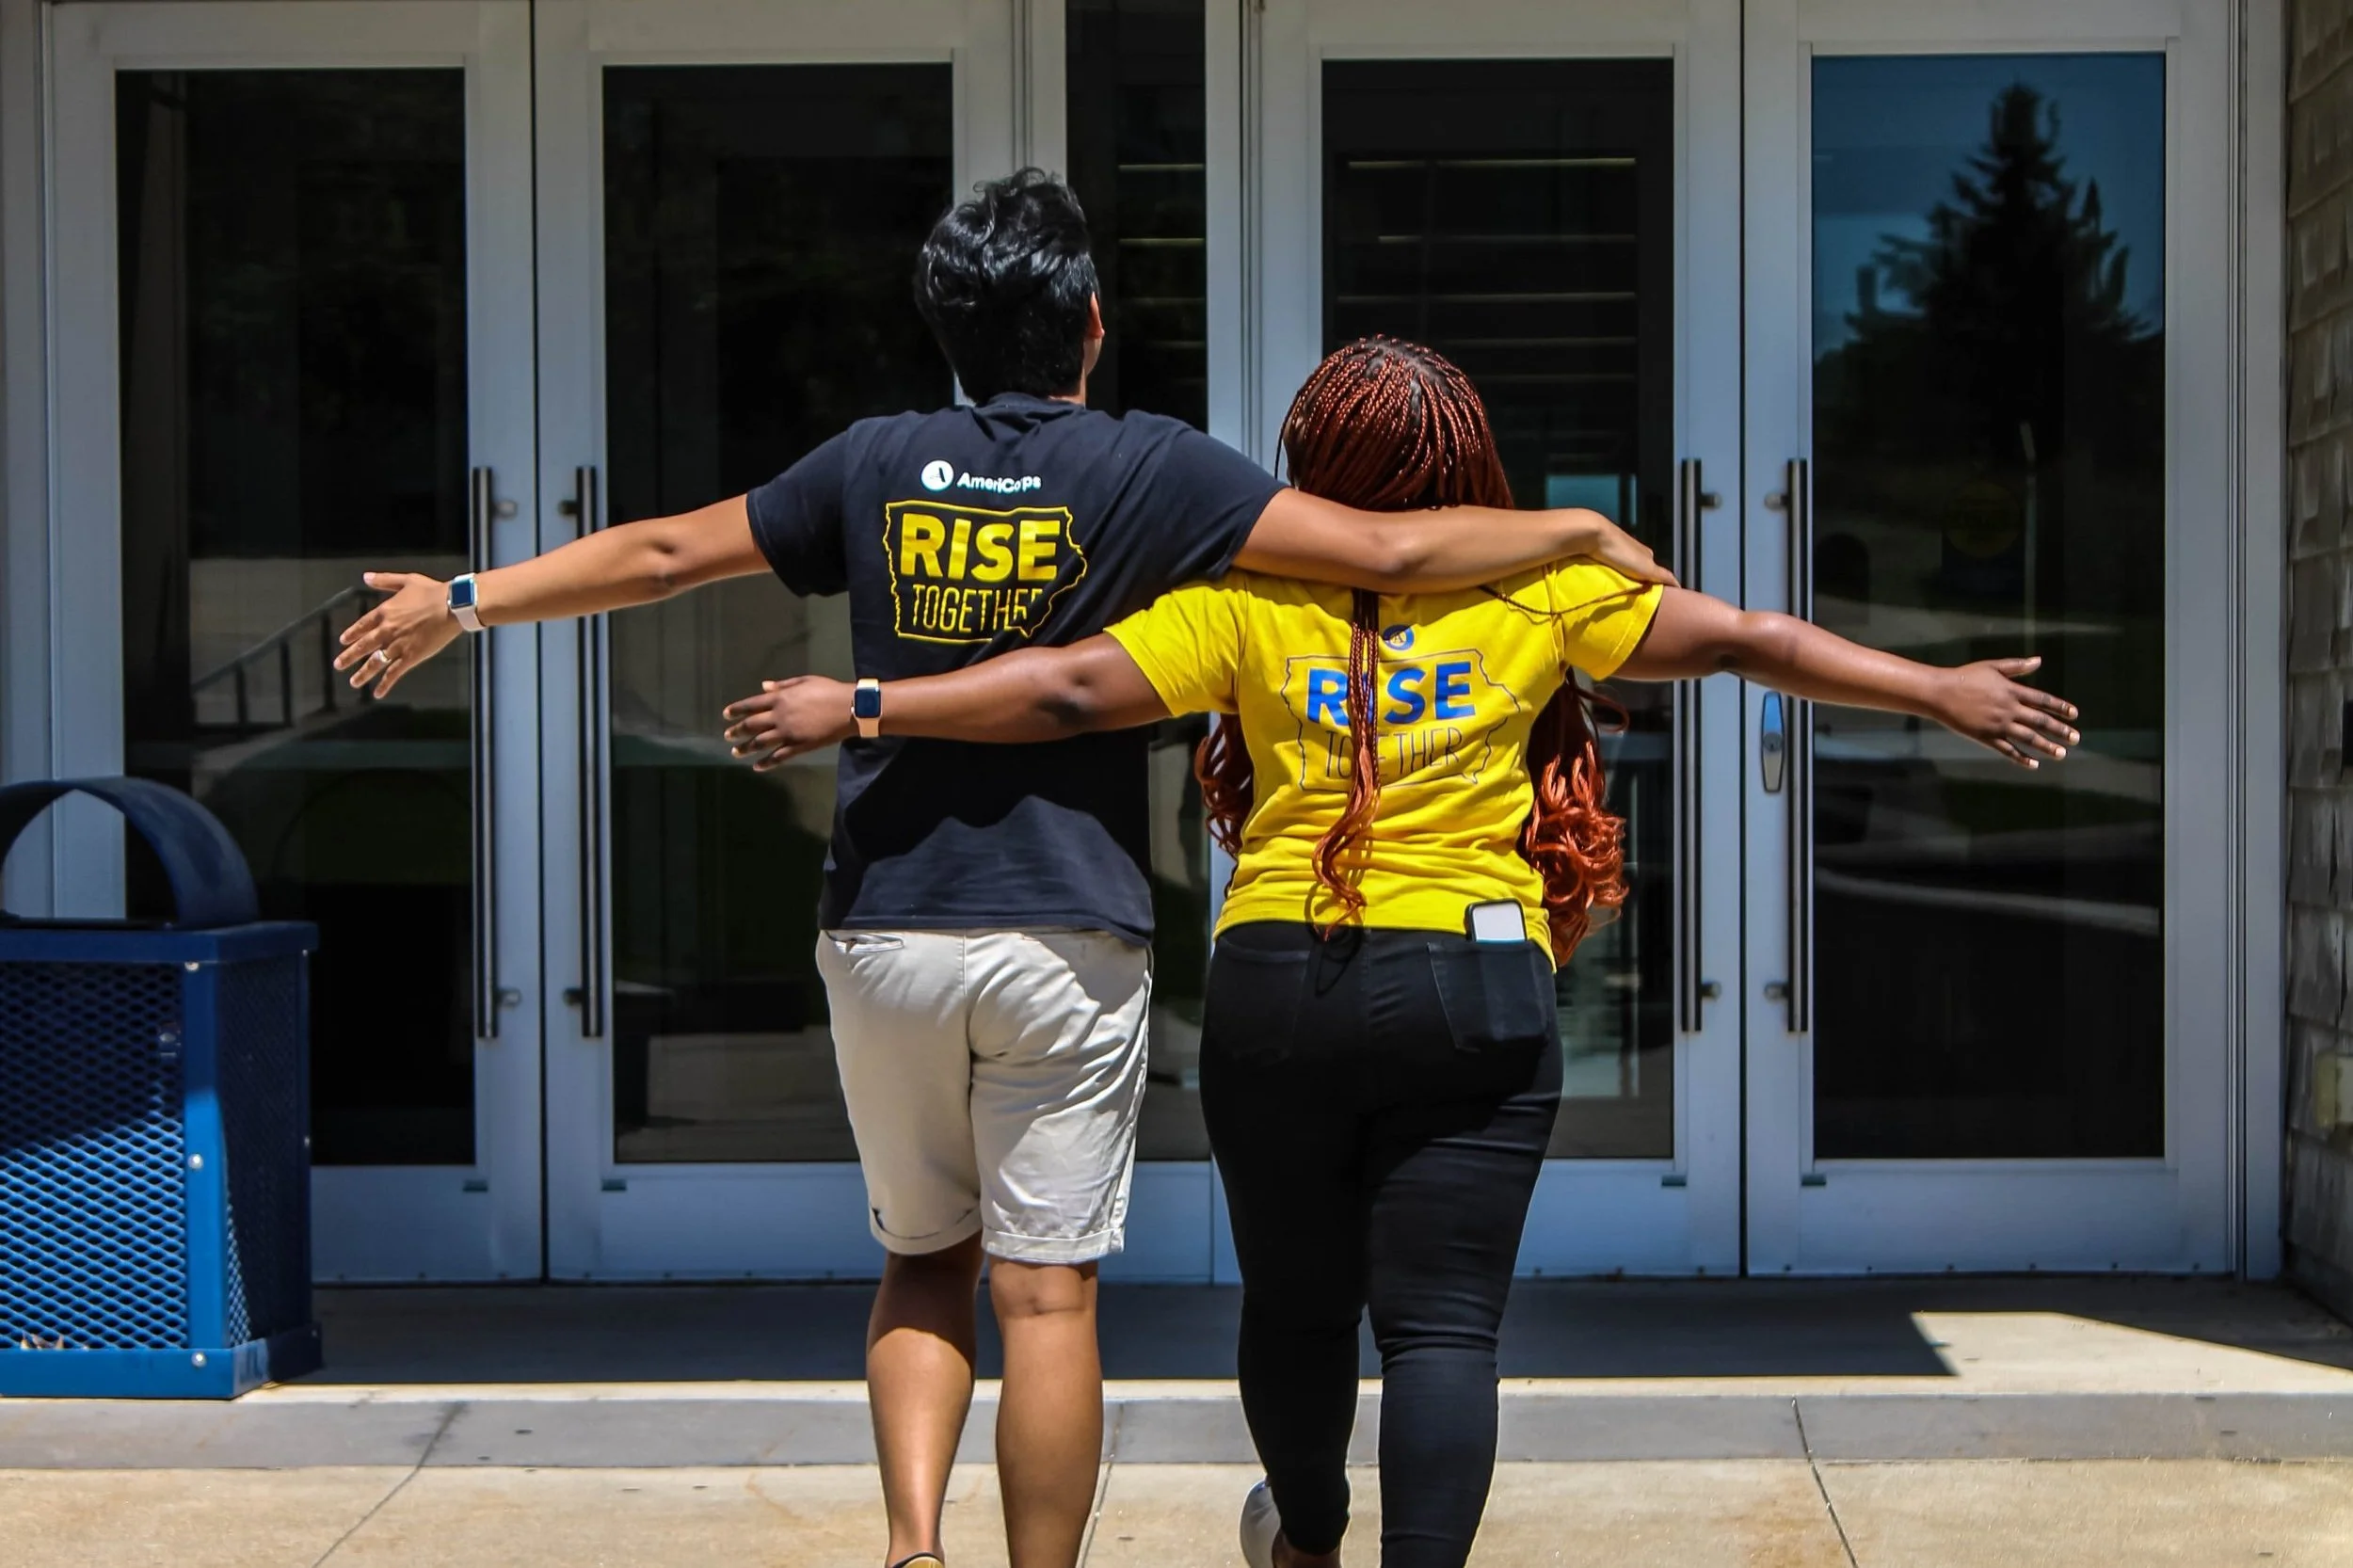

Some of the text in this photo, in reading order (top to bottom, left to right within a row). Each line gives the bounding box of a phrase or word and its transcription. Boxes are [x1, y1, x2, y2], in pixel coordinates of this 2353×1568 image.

[957, 472, 1041, 493] AmeriCops
[900, 513, 1061, 582] RISE
[1325, 727, 1463, 779] TOETHER
